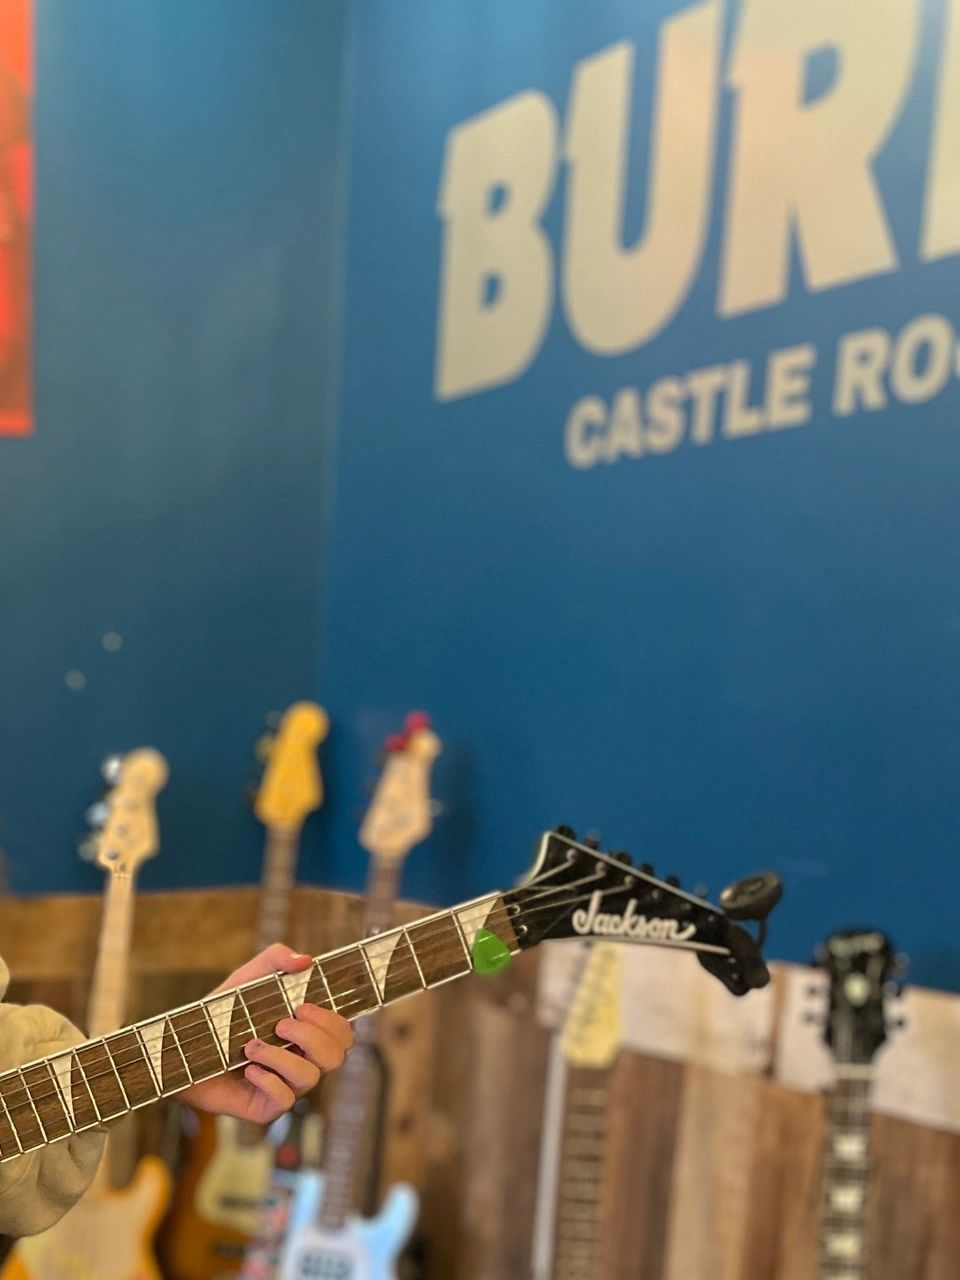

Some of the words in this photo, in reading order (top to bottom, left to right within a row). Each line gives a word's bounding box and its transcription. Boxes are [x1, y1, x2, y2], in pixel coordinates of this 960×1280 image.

[433, 0, 960, 402] BUR
[564, 344, 816, 470] CASTLE
[832, 313, 960, 417] RO
[572, 889, 697, 940] Jackson
